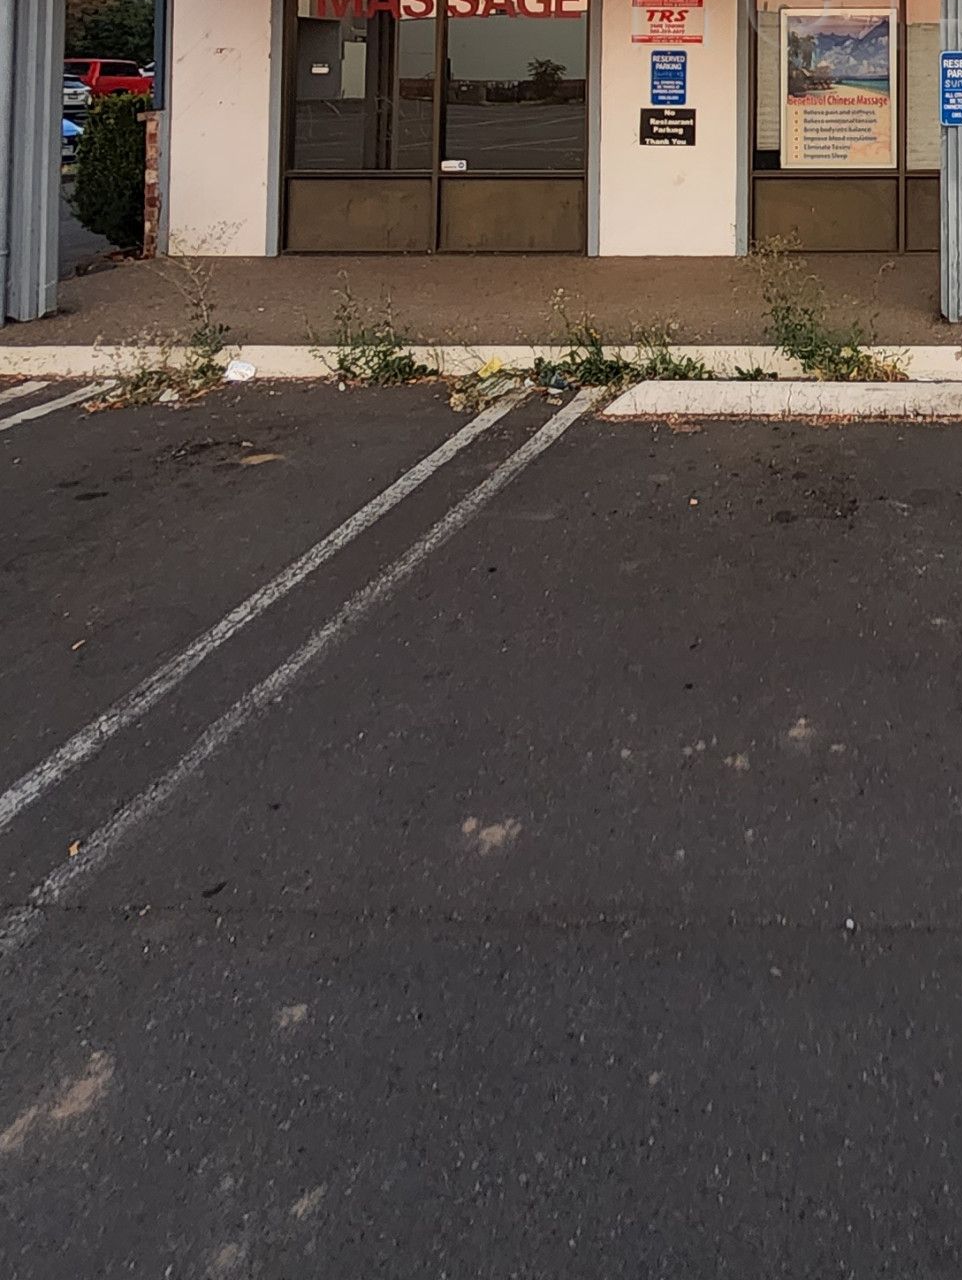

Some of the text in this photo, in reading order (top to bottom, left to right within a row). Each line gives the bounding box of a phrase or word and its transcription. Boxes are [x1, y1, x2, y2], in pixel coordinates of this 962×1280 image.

[646, 9, 689, 22] TRS
[828, 95, 856, 105] Chinese
[857, 95, 888, 107] Massage
[650, 118, 693, 126] Restaurant
[653, 126, 683, 135] Parking
